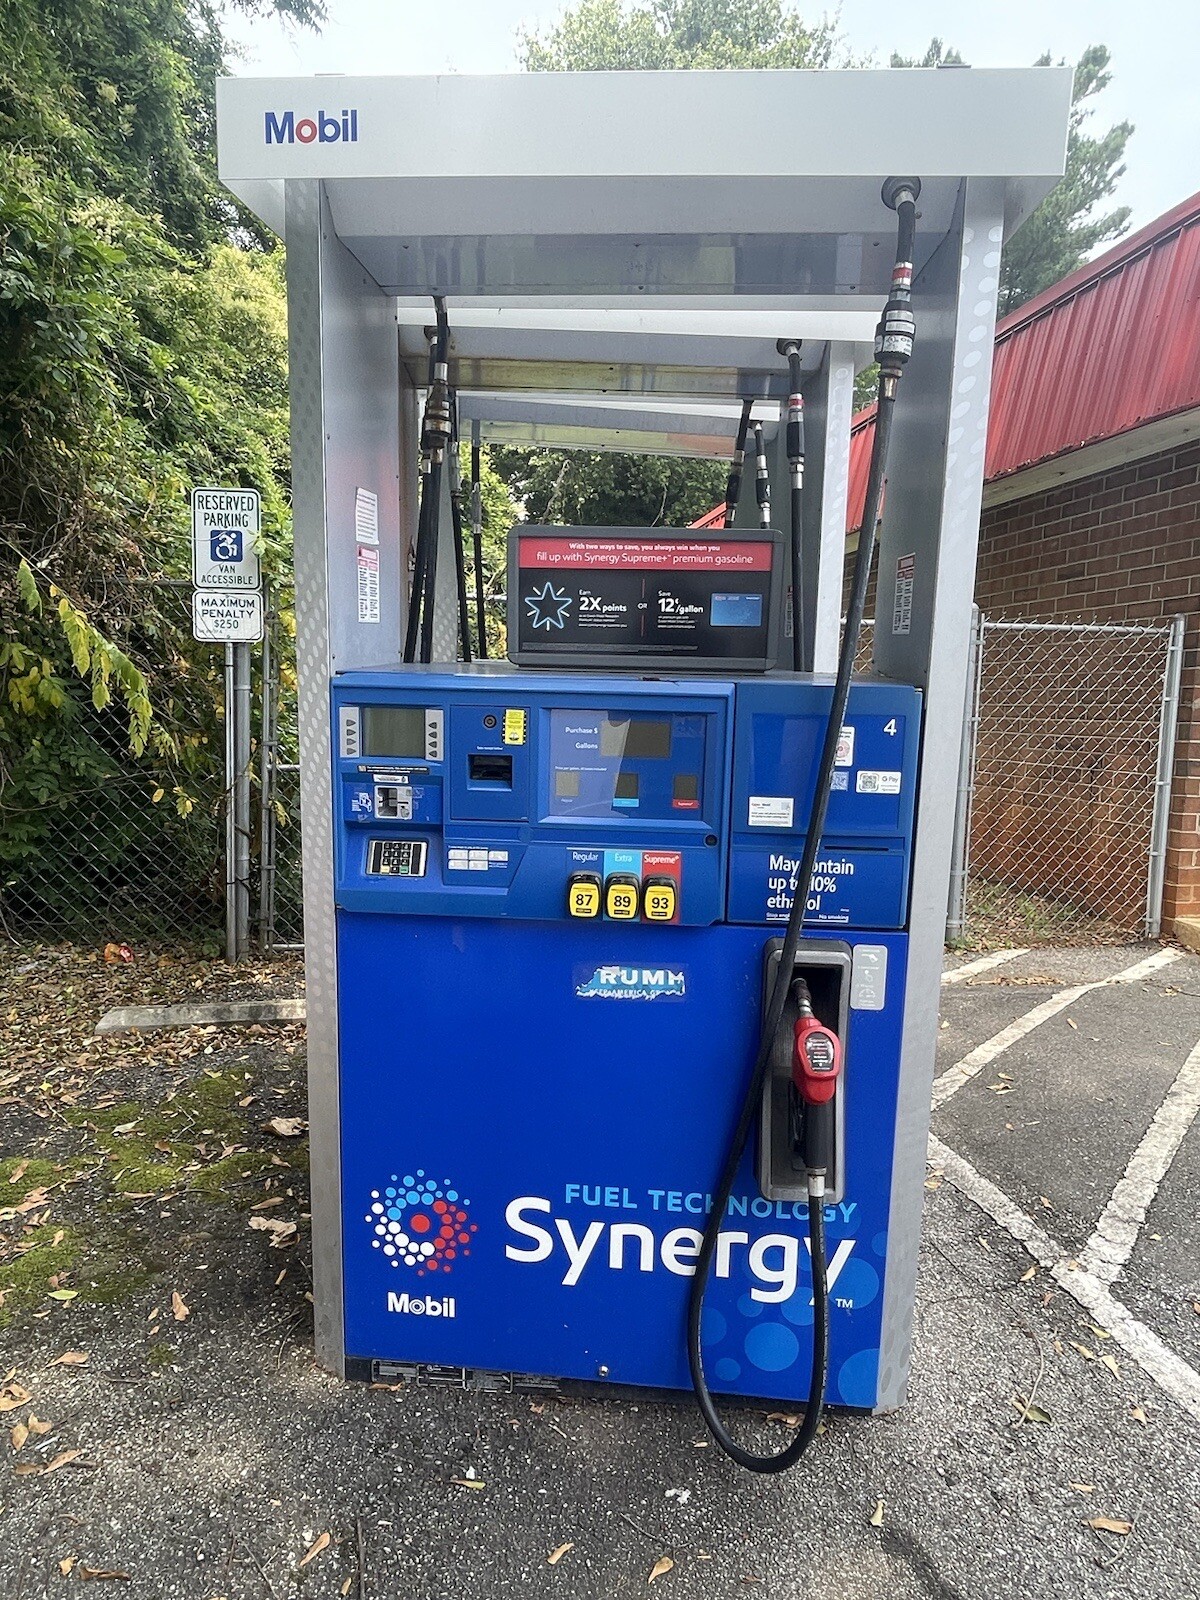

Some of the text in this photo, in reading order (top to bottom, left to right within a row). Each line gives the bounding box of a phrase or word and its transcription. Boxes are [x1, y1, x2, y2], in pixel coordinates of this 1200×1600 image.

[265, 109, 357, 144] Mobil
[198, 494, 254, 512] RESERVED
[204, 513, 249, 528] PARKING
[654, 544, 676, 552] always
[536, 552, 547, 561] fill
[549, 554, 561, 563] up
[562, 552, 582, 561] with
[584, 553, 620, 565] Synergy
[673, 554, 713, 565] premium
[715, 554, 753, 566] gasoline
[218, 564, 236, 573] VAN
[201, 574, 253, 585] ACCESSIBLE
[201, 598, 255, 608] MAXIMUM
[579, 596, 627, 614] 2X points
[202, 609, 254, 619] PENALTY
[214, 620, 239, 629] $250
[884, 718, 897, 737] 4
[573, 852, 599, 863] Regular
[615, 853, 633, 863] Extra
[770, 854, 854, 876] May ontain
[769, 878, 787, 894] up
[576, 894, 593, 906] 87
[614, 896, 631, 908] 89
[652, 898, 669, 909] 93
[565, 1184, 637, 1209] FUEL
[504, 1196, 856, 1306] Synergy
[388, 1292, 456, 1318] Mobil
